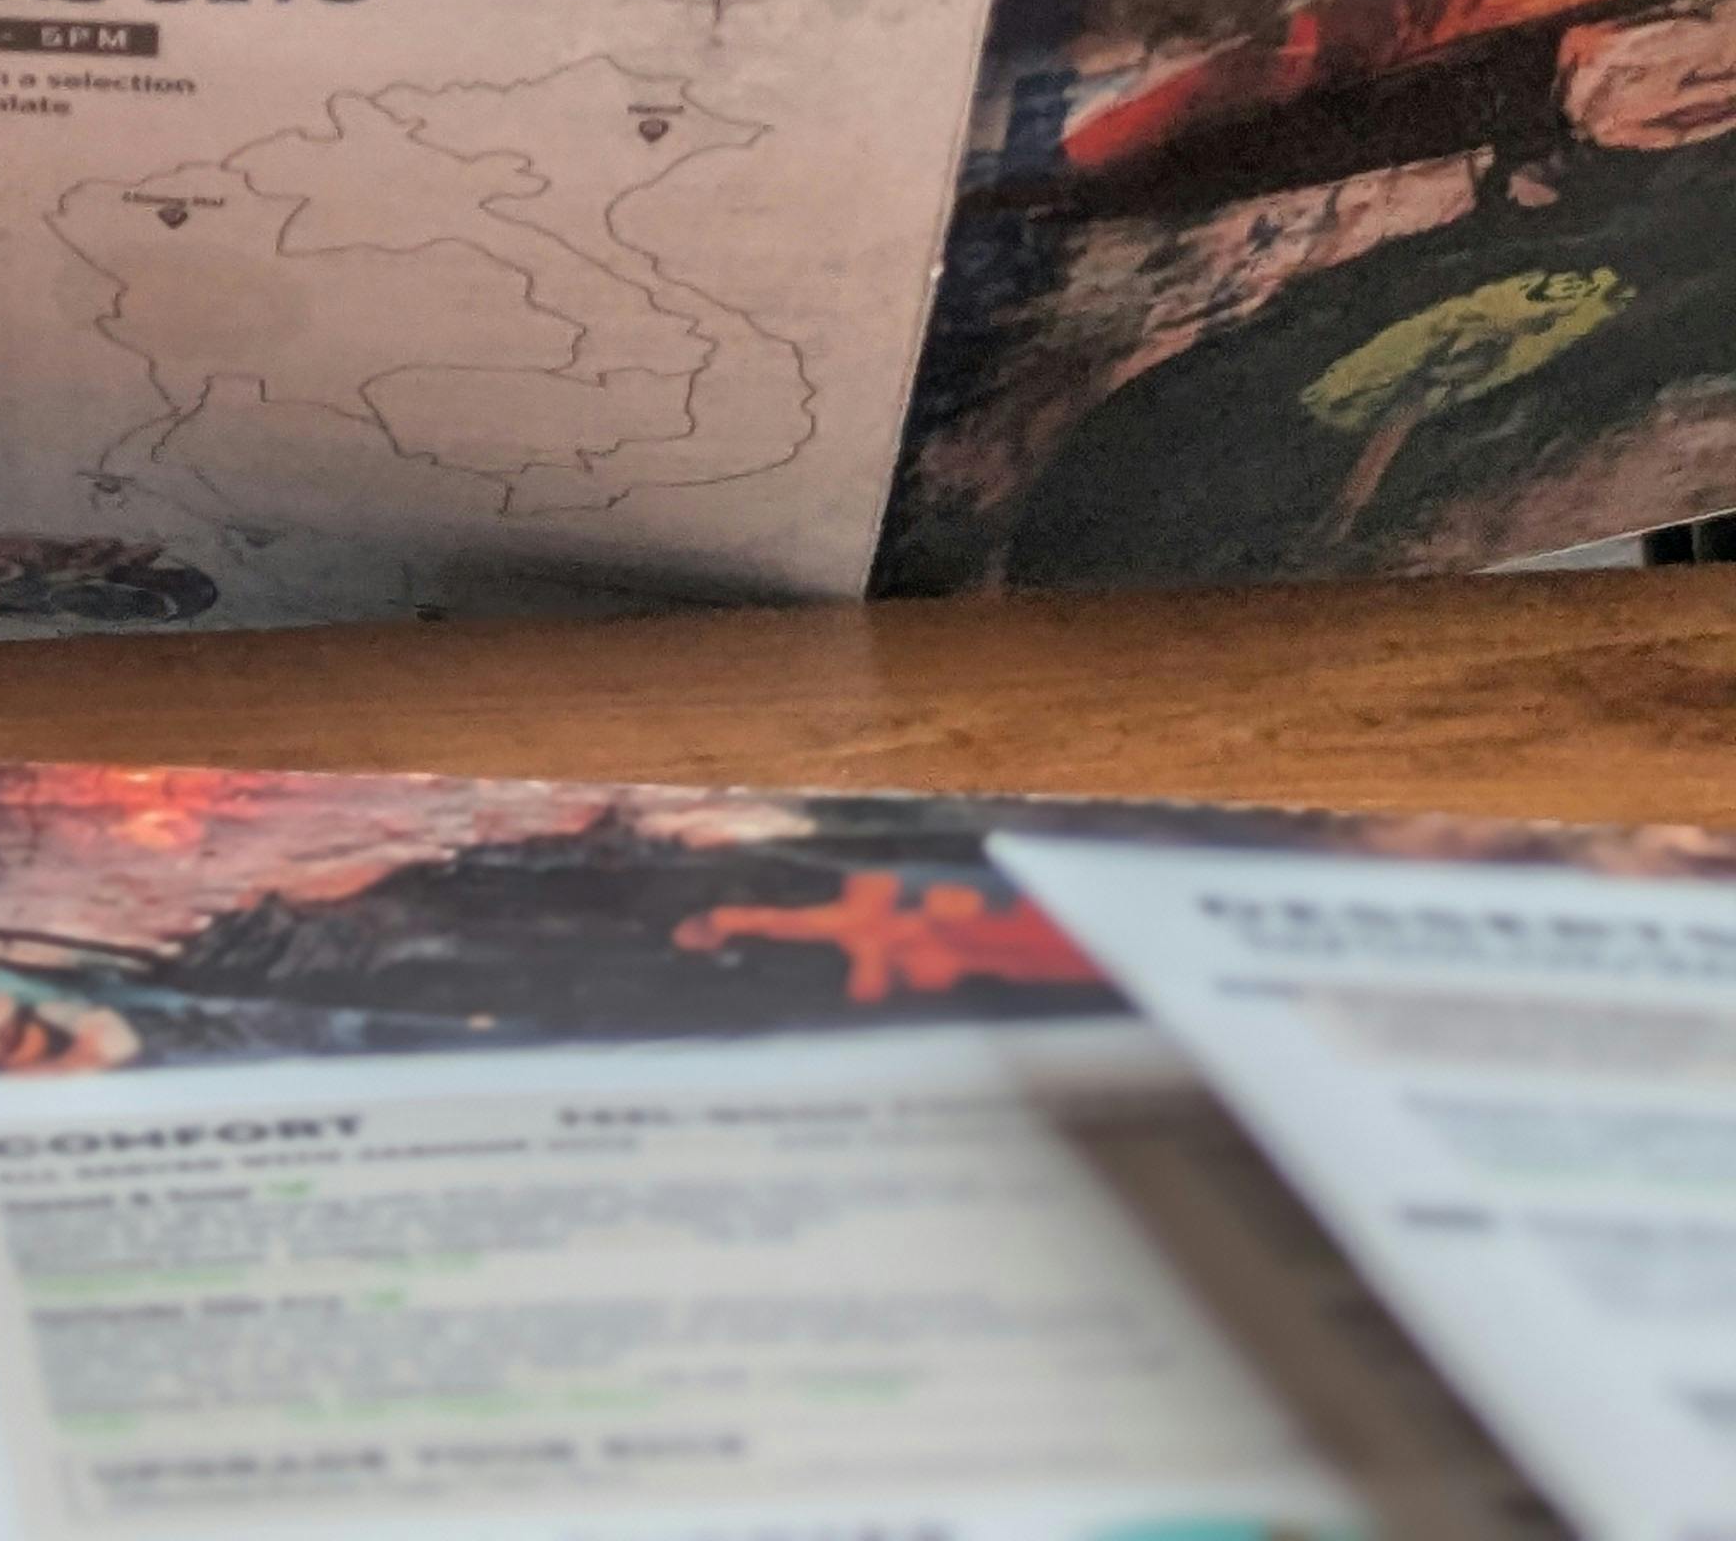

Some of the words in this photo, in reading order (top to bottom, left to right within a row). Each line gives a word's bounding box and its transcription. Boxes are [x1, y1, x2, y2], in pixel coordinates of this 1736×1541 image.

[41, 25, 127, 49] 5PM
[18, 72, 37, 90] a
[47, 72, 196, 97] selection
